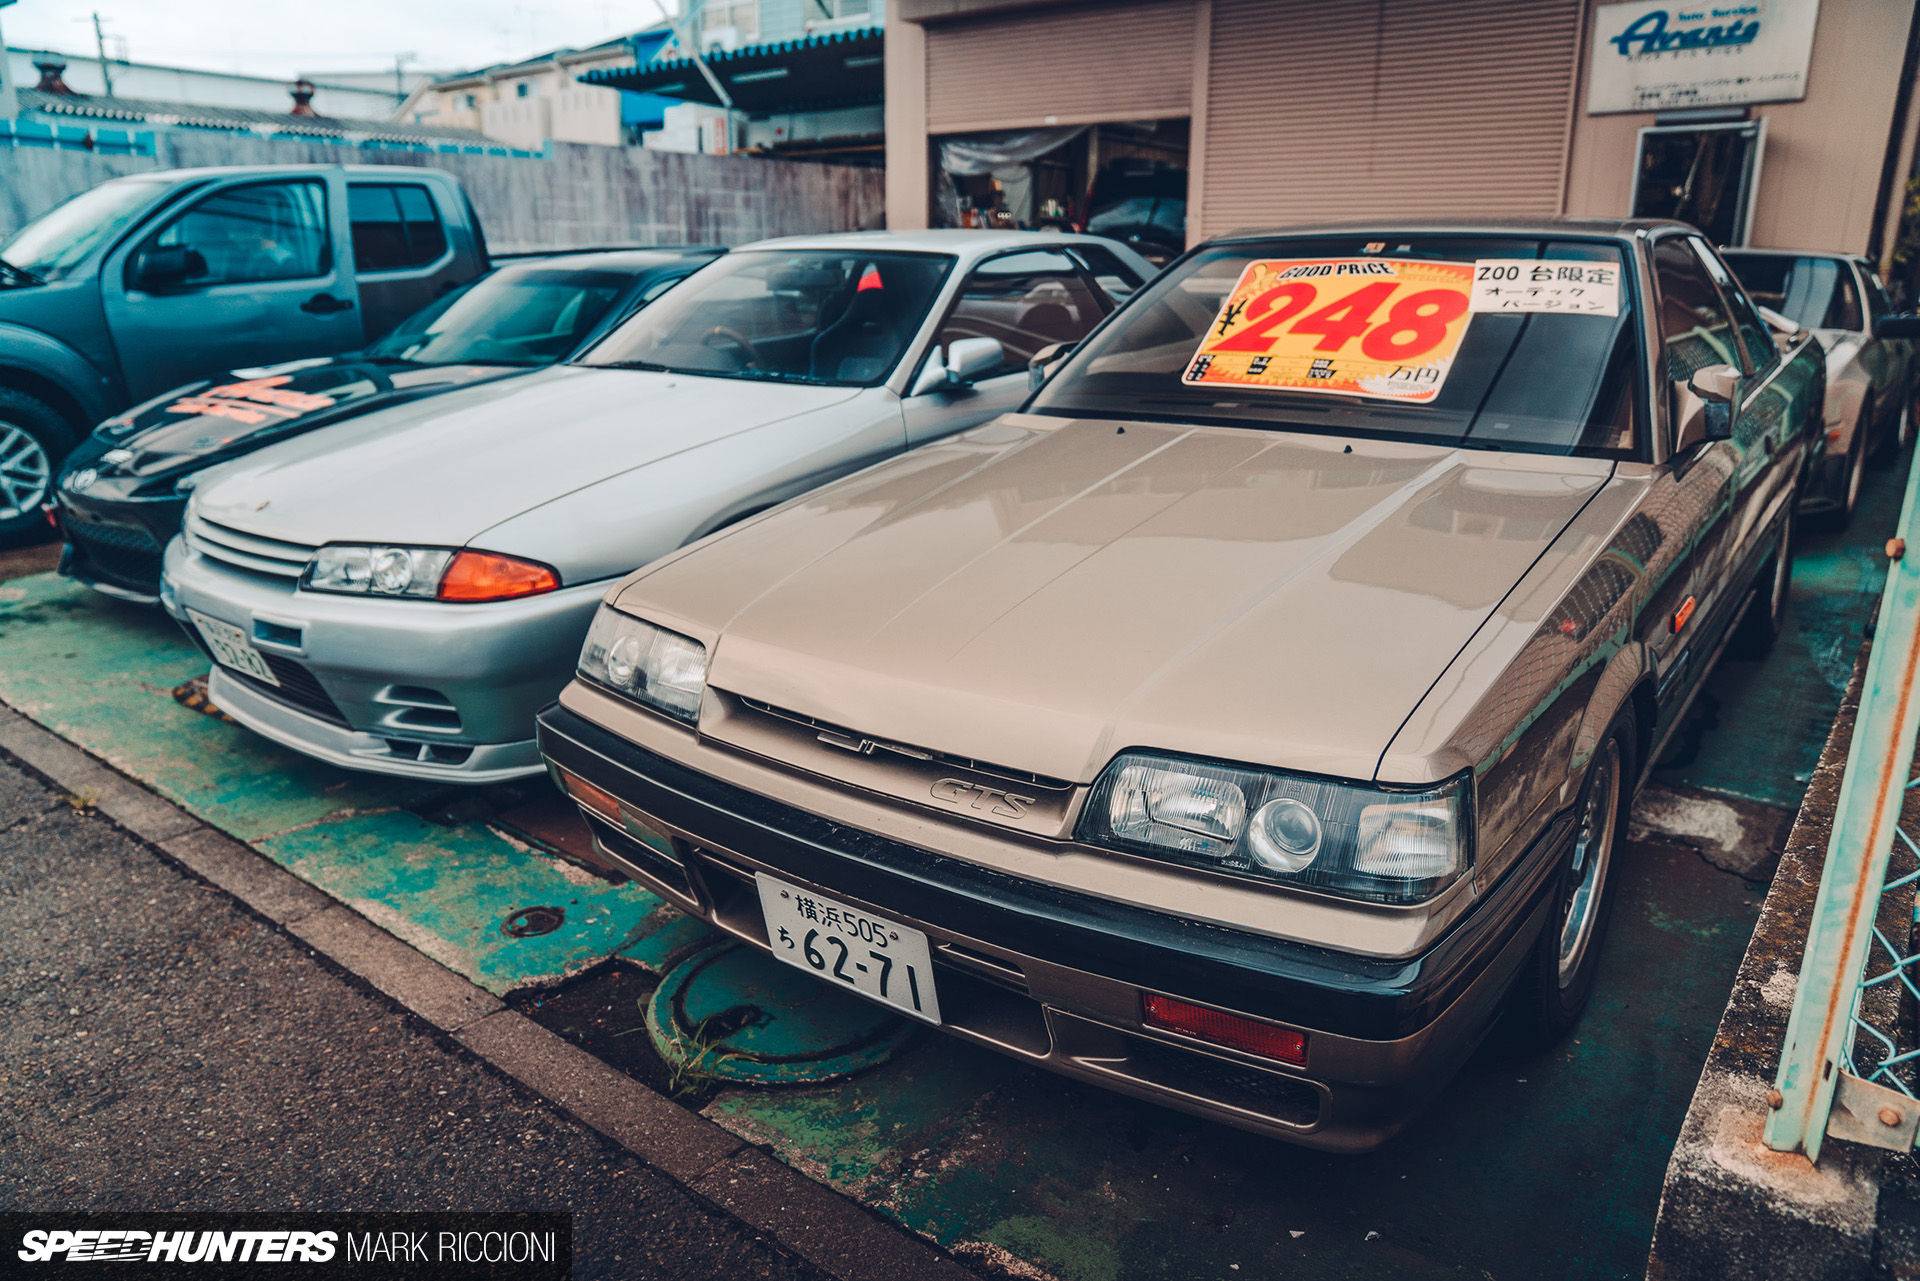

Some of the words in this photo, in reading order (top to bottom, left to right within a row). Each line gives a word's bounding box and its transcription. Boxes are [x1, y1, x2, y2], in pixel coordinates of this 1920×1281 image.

[1281, 264, 1333, 279] GOOD
[1336, 261, 1394, 276] PRICE
[1477, 266, 1520, 281] 200
[1485, 286, 1585, 297] オーテック
[1207, 282, 1469, 361] 248
[1388, 364, 1440, 384] 万円
[930, 777, 1036, 820] GTS
[777, 925, 795, 949] ち
[804, 928, 922, 1012] 62-71
